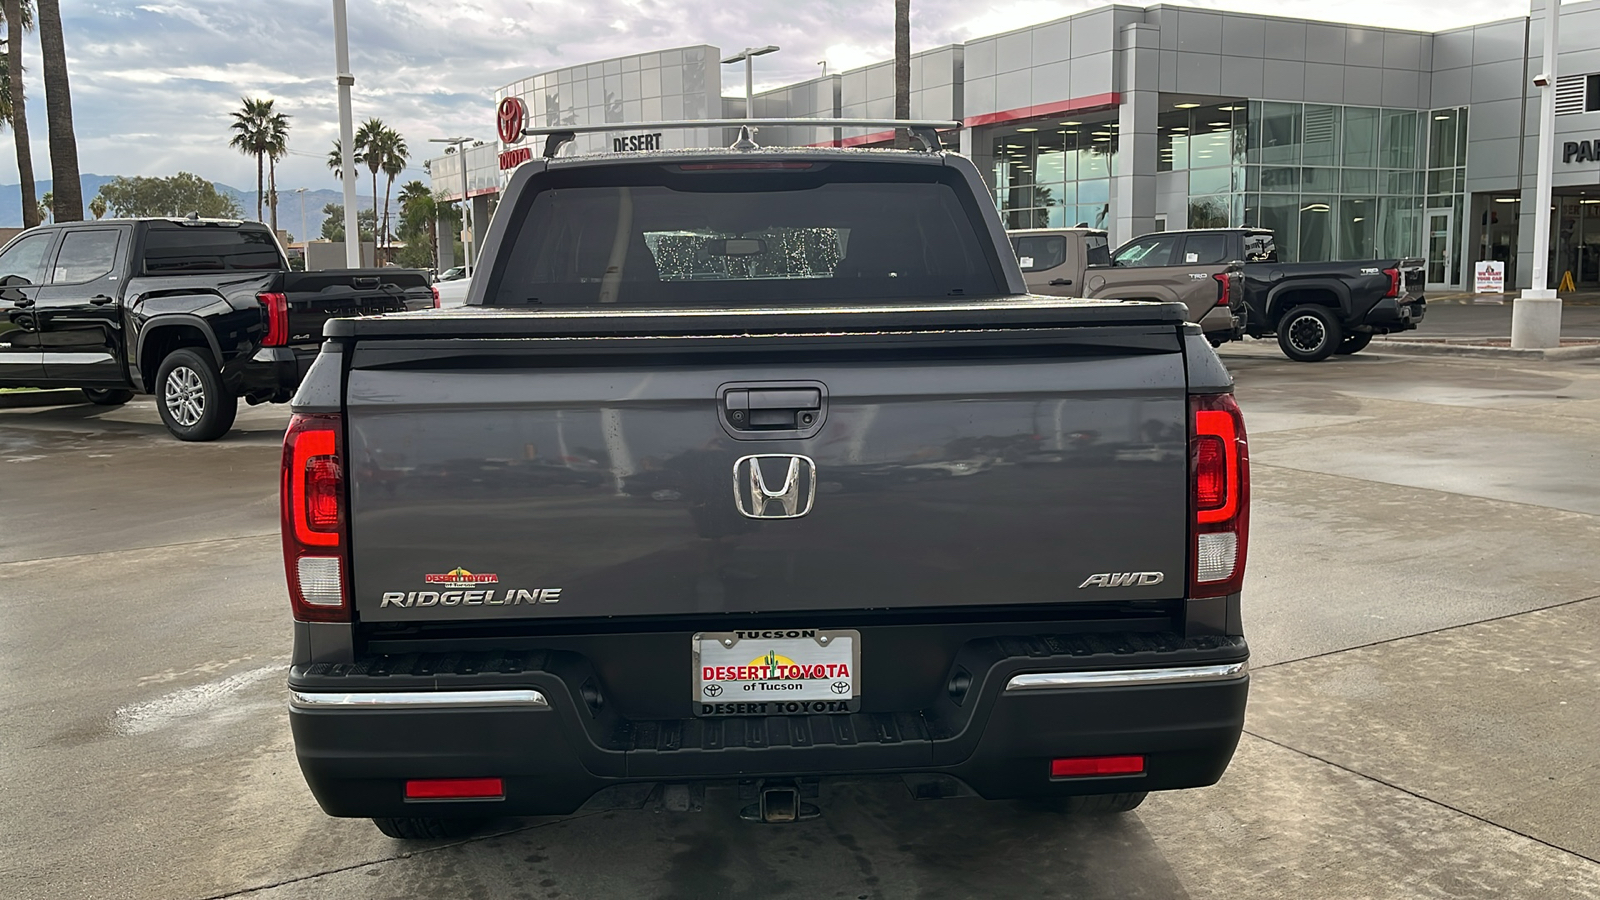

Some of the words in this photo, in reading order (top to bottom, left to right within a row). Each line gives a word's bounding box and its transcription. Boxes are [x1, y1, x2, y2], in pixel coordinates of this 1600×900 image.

[613, 133, 662, 152] DESERT
[498, 148, 530, 170] TOYOTA
[426, 574, 458, 582] DESERT
[462, 574, 498, 582] TOYOTA
[1078, 571, 1165, 589] AWD
[380, 588, 563, 608] RIDGELINE
[736, 630, 816, 639] TUCSON
[702, 666, 771, 681] DESERT
[779, 664, 850, 679] TOYOTA
[743, 682, 756, 691] of
[758, 682, 803, 691] Tucson
[702, 703, 768, 715] DESERT
[776, 702, 850, 714] TOYOTA
